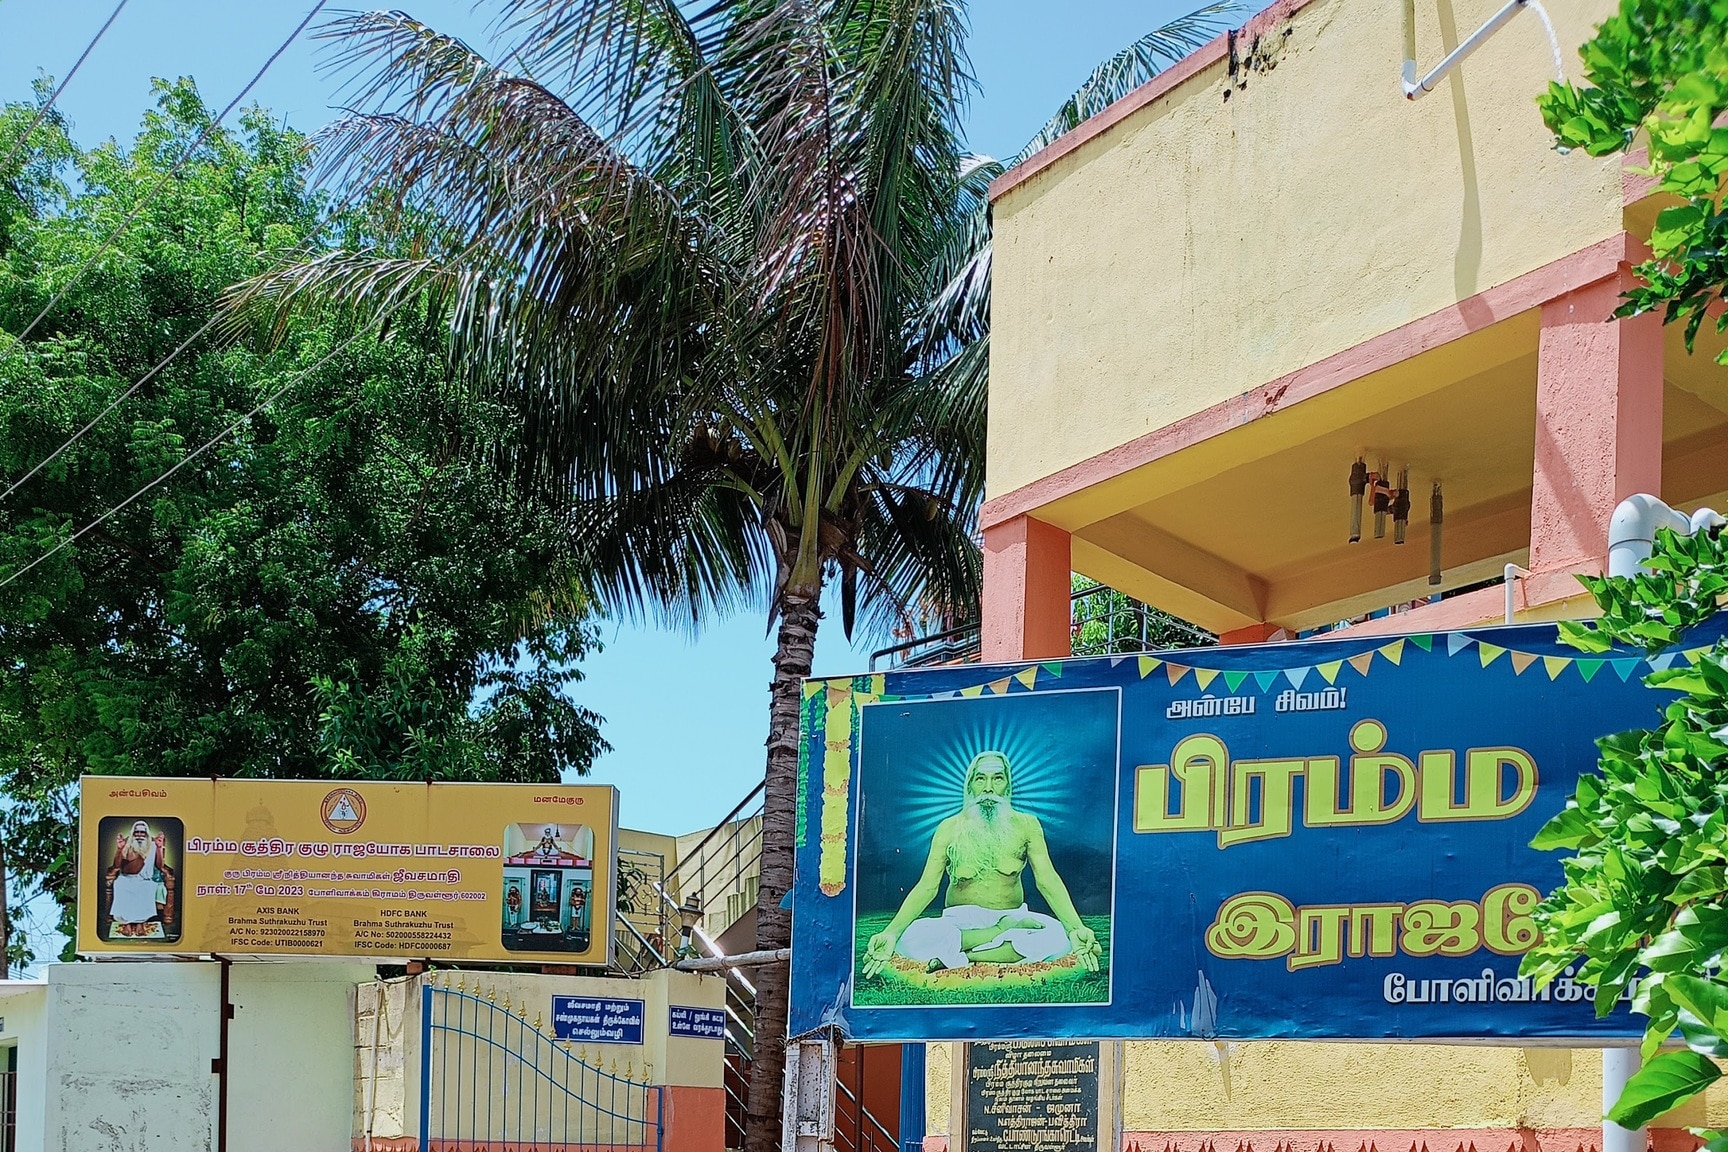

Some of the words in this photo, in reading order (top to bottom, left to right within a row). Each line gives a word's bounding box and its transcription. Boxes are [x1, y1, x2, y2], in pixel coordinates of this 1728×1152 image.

[1166, 694, 1255, 719] அன்பே
[1275, 687, 1347, 712] சிவம்!
[1132, 718, 1537, 848] பிரம்ம
[108, 788, 168, 798] அன்பேசிவம்
[533, 795, 584, 805] மனமேகுரு
[187, 837, 238, 854] பிரம்ம
[241, 838, 295, 856] சூத்திர
[299, 841, 329, 856] குழு
[333, 842, 411, 857] ராஜயோக
[415, 845, 500, 857] பாடசாலை
[392, 868, 462, 883] ஜீவசமாதி
[197, 883, 231, 896] நாள்:
[255, 885, 275, 896] மே
[278, 885, 304, 896] 2023
[460, 892, 486, 900] 602002
[256, 907, 275, 915] AXIS
[277, 907, 300, 915] BANK
[380, 909, 402, 917] HDFC
[404, 910, 427, 918] BANK
[228, 917, 257, 925] Brahma
[259, 917, 306, 926] Suthrakuzhu
[307, 918, 328, 927] Trust
[353, 920, 383, 928] Brahma
[385, 920, 433, 929] Suthrakuzhu
[434, 921, 454, 929] Trust
[355, 930, 369, 938] A/C
[371, 930, 384, 938] No:
[231, 938, 249, 946] IFSC
[250, 938, 273, 946] Code:
[374, 941, 397, 949] Code:
